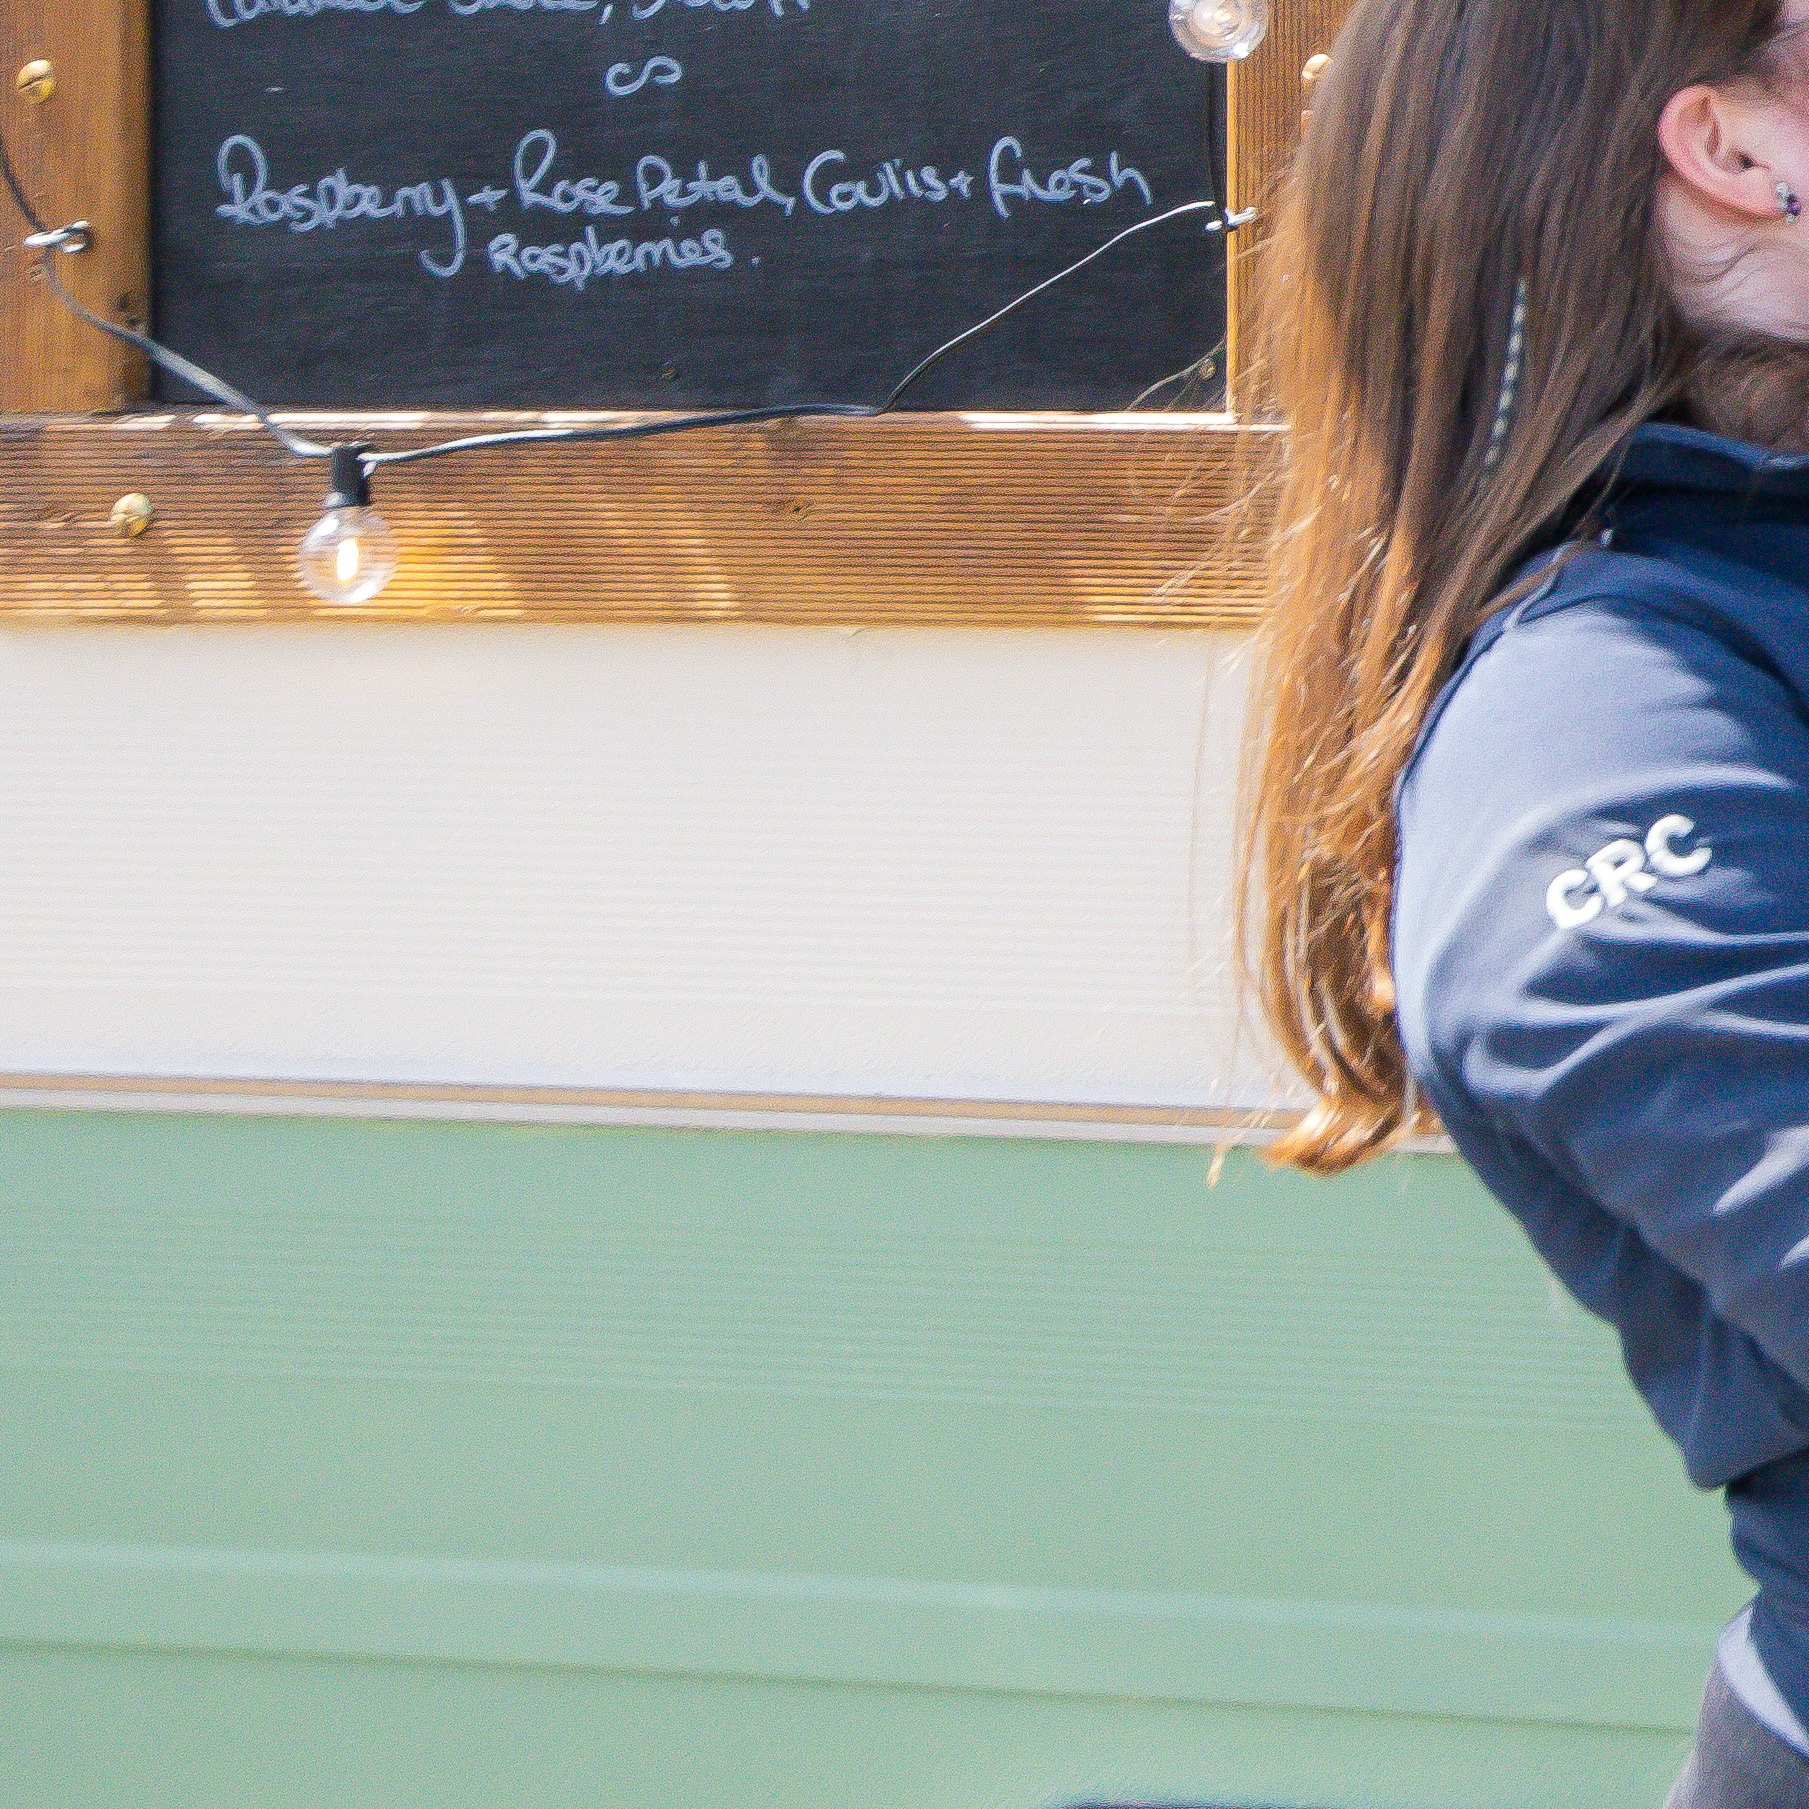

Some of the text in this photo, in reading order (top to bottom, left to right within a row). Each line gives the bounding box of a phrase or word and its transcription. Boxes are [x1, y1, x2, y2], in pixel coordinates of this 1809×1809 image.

[215, 134, 465, 278] Raspberry
[512, 128, 634, 215] Rose
[1546, 813, 1713, 930] CRC
